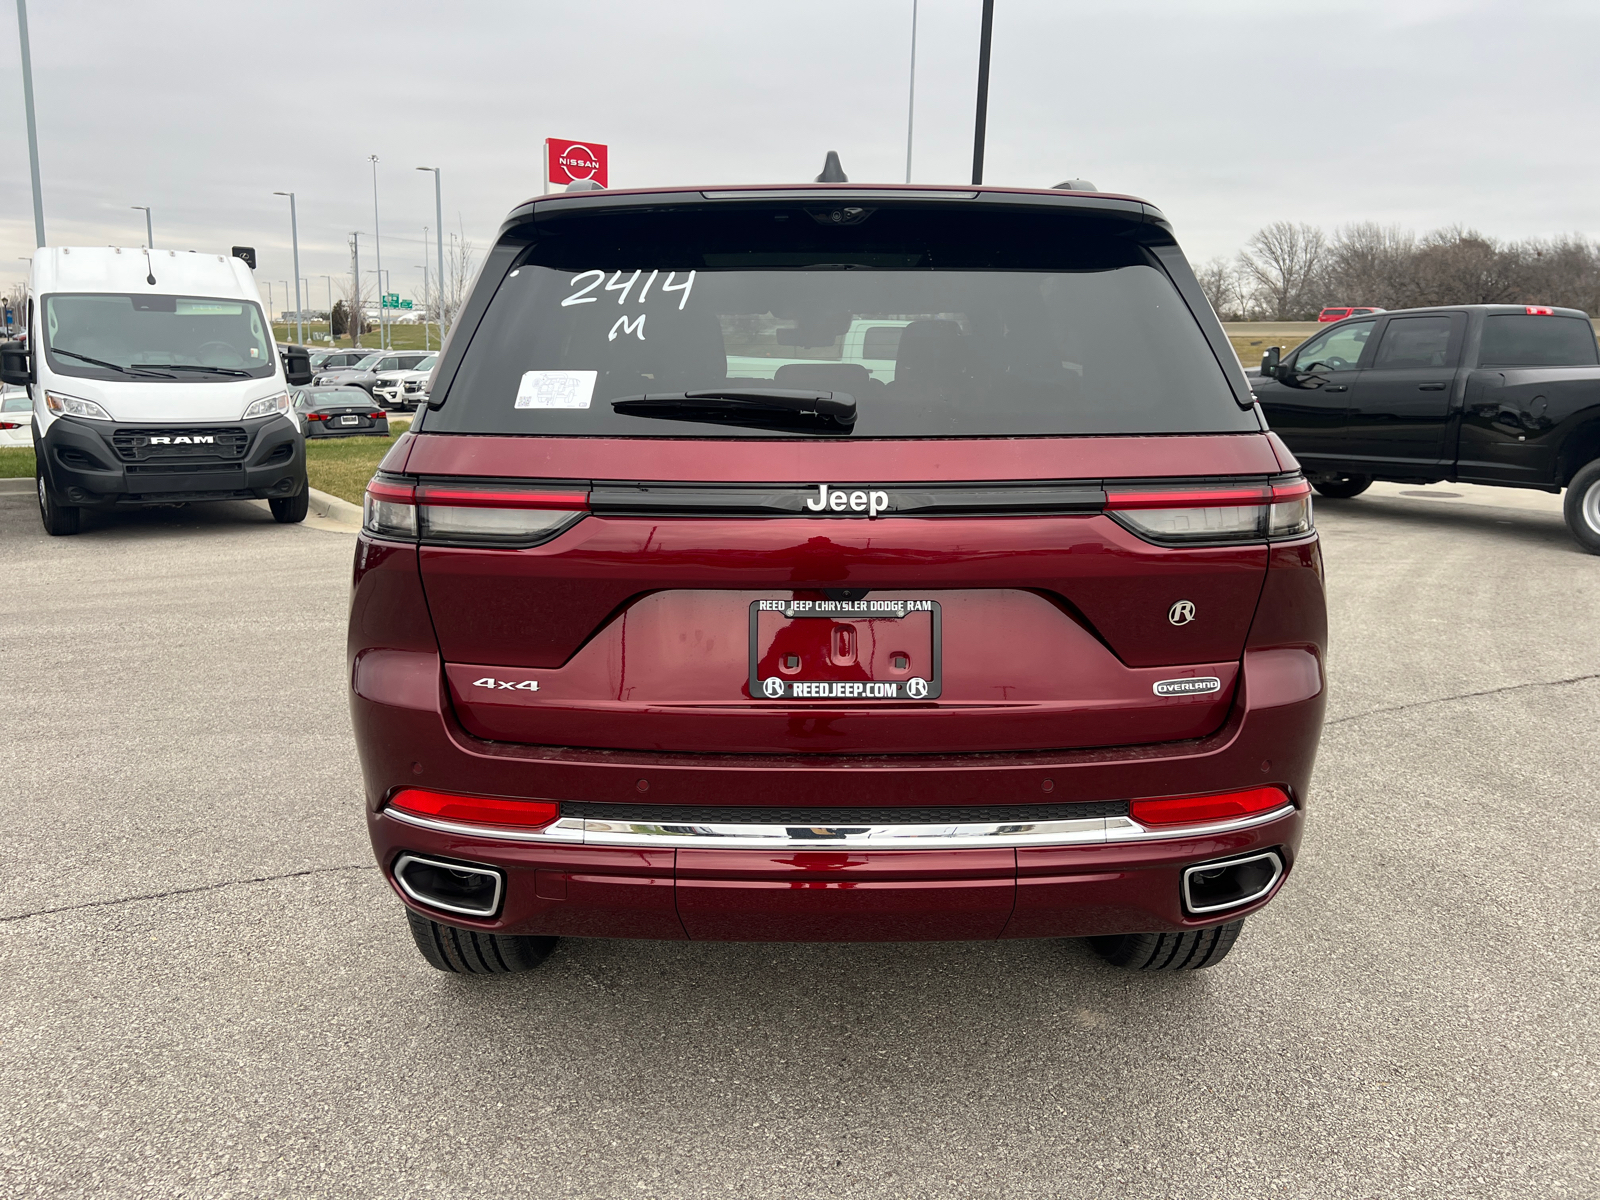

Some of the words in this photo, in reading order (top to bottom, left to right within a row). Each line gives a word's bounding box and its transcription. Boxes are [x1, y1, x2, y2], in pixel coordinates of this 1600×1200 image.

[559, 157, 599, 169] NISSAN
[561, 269, 696, 310] 2414
[608, 314, 646, 341] M
[150, 436, 214, 444] RAM
[807, 485, 889, 516] Jeep
[759, 601, 785, 611] REED
[790, 601, 813, 611] JEEP
[815, 601, 868, 611] CHRYSLER
[870, 601, 904, 611] DODGE
[907, 601, 932, 611] RAM
[472, 677, 541, 692] 4x4
[792, 682, 897, 698] REEDJEEP.COM
[1158, 681, 1218, 693] OVERLAND
